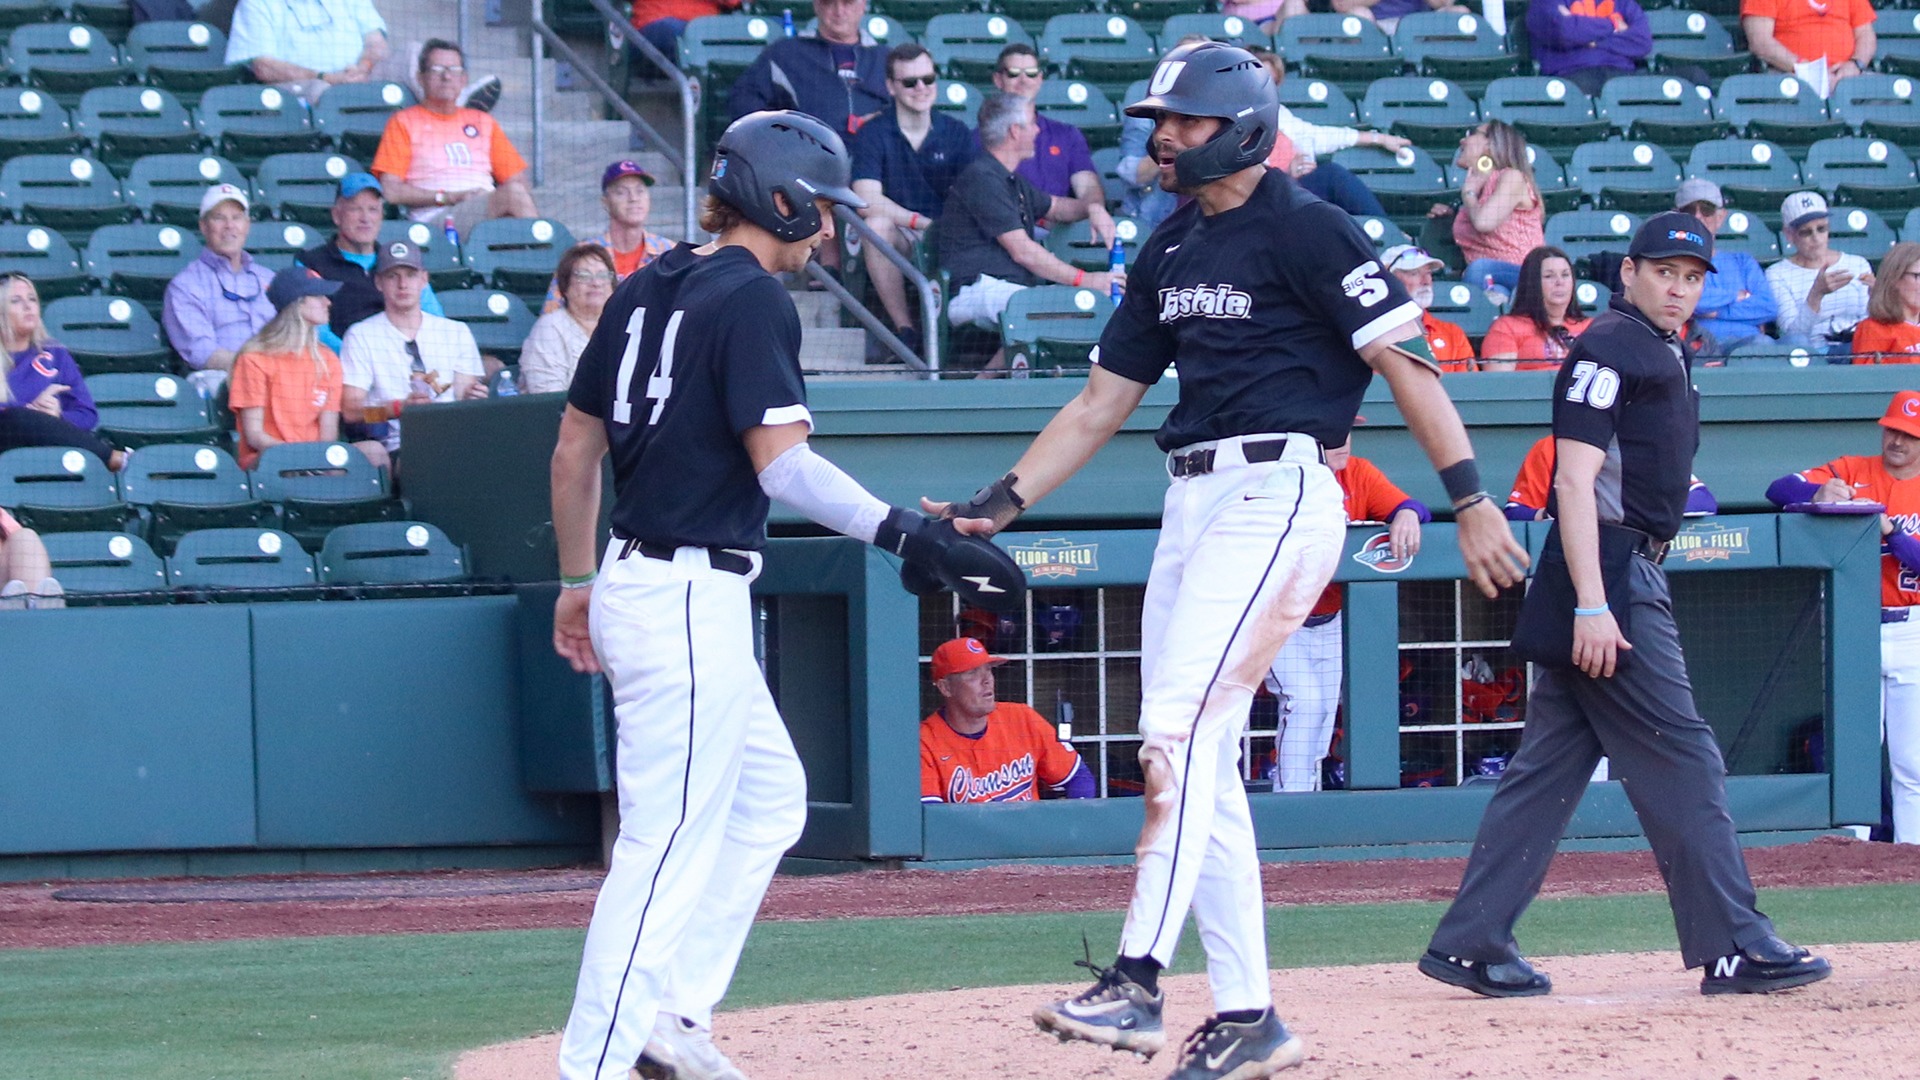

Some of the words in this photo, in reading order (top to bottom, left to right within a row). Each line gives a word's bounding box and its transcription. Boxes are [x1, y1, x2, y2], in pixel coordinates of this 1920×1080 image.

[1151, 61, 1187, 95] U
[443, 142, 471, 166] 10
[31, 351, 58, 378] C
[613, 306, 685, 425] 14
[1566, 361, 1621, 410] 70
[1902, 399, 1919, 416] C
[1711, 532, 1742, 548] FIELD
[1014, 550, 1049, 565] FLUOR
[1058, 548, 1091, 565] FIELD
[966, 638, 984, 653] C
[948, 752, 1034, 803] Clemson
[1714, 955, 1740, 978] N
